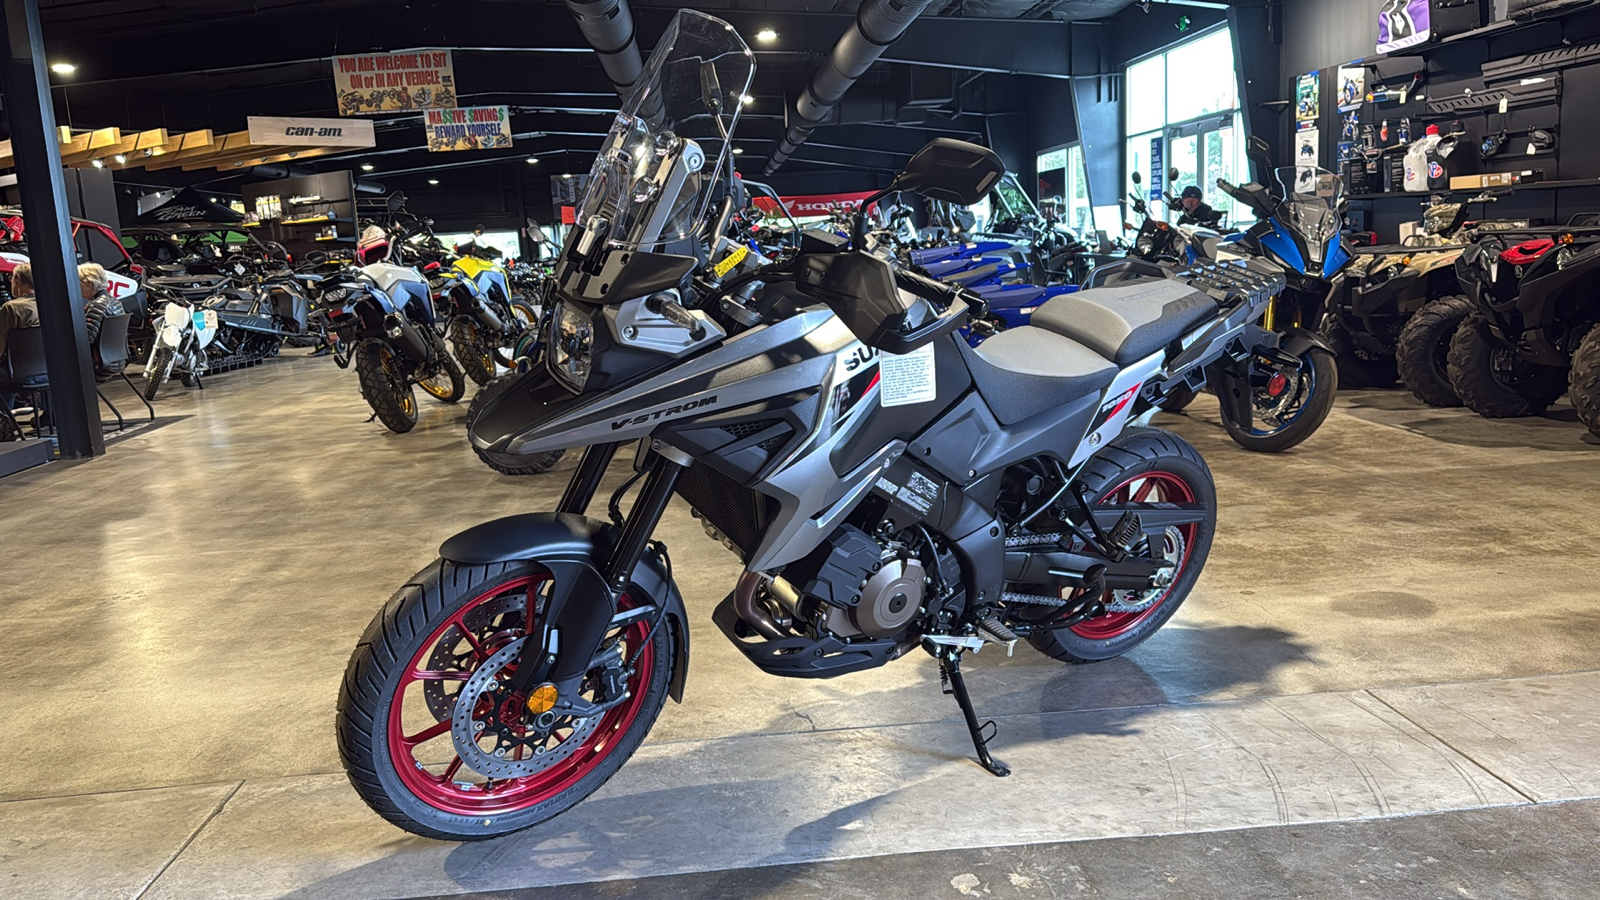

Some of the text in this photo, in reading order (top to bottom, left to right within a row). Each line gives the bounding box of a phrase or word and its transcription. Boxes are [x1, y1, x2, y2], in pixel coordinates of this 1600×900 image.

[338, 52, 447, 73] YOU ARE WELCOME TO SIT
[350, 74, 363, 89] ON
[364, 76, 374, 88] or
[375, 73, 385, 88] IN
[386, 71, 404, 87] ANY
[405, 70, 440, 87] VEHICLE
[285, 126, 343, 137] can-am
[434, 124, 466, 138] REWARD
[466, 122, 502, 137] YOURSELF
[1102, 390, 1132, 413] 1050
[611, 395, 718, 431] V-STROM
